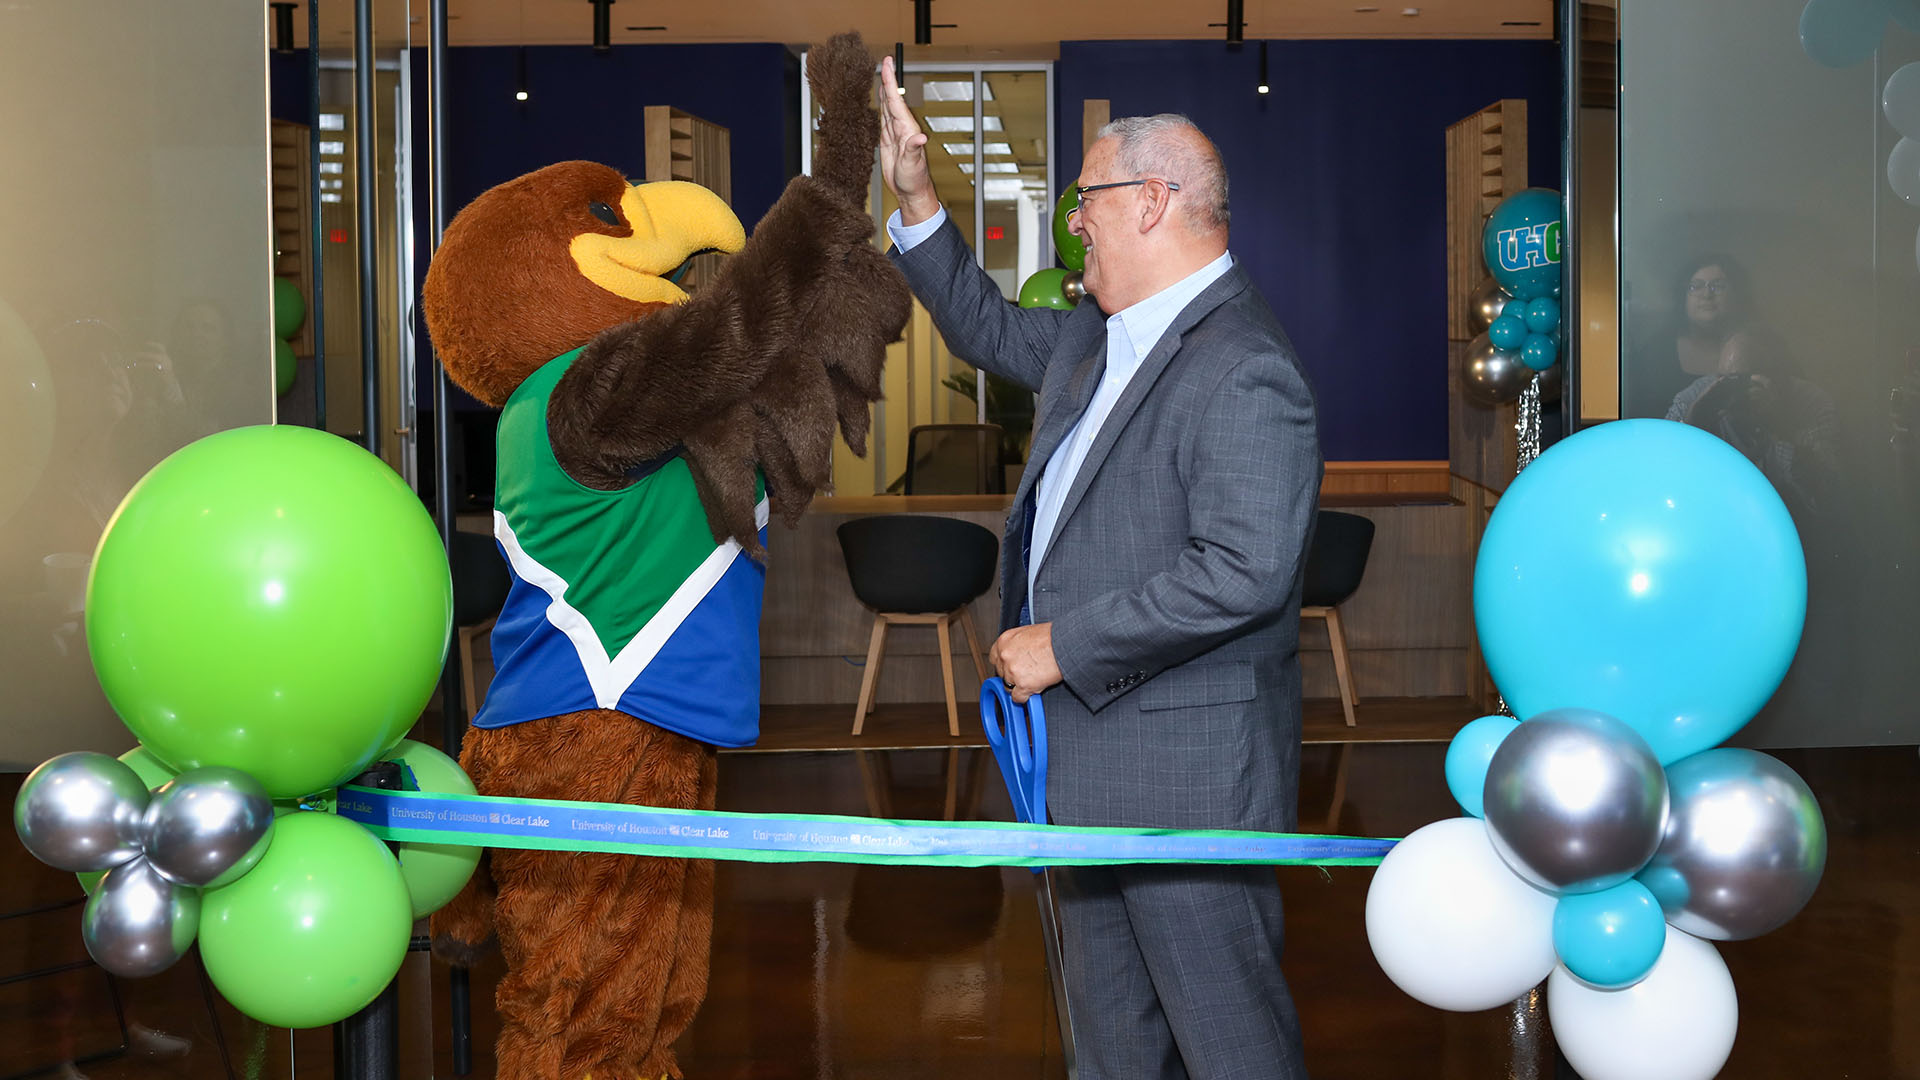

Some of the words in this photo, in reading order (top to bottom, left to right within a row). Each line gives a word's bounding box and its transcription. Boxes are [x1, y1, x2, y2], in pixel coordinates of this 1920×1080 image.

[1497, 221, 1560, 271] UHC
[353, 800, 373, 814] Lake
[392, 807, 436, 822] University
[438, 809, 448, 820] of
[450, 810, 488, 823] Houston
[501, 814, 525, 825] Clear
[527, 815, 550, 827] Lake
[571, 819, 616, 835] University
[618, 822, 628, 833] of
[681, 825, 705, 837] Clear
[707, 827, 729, 839] Lake
